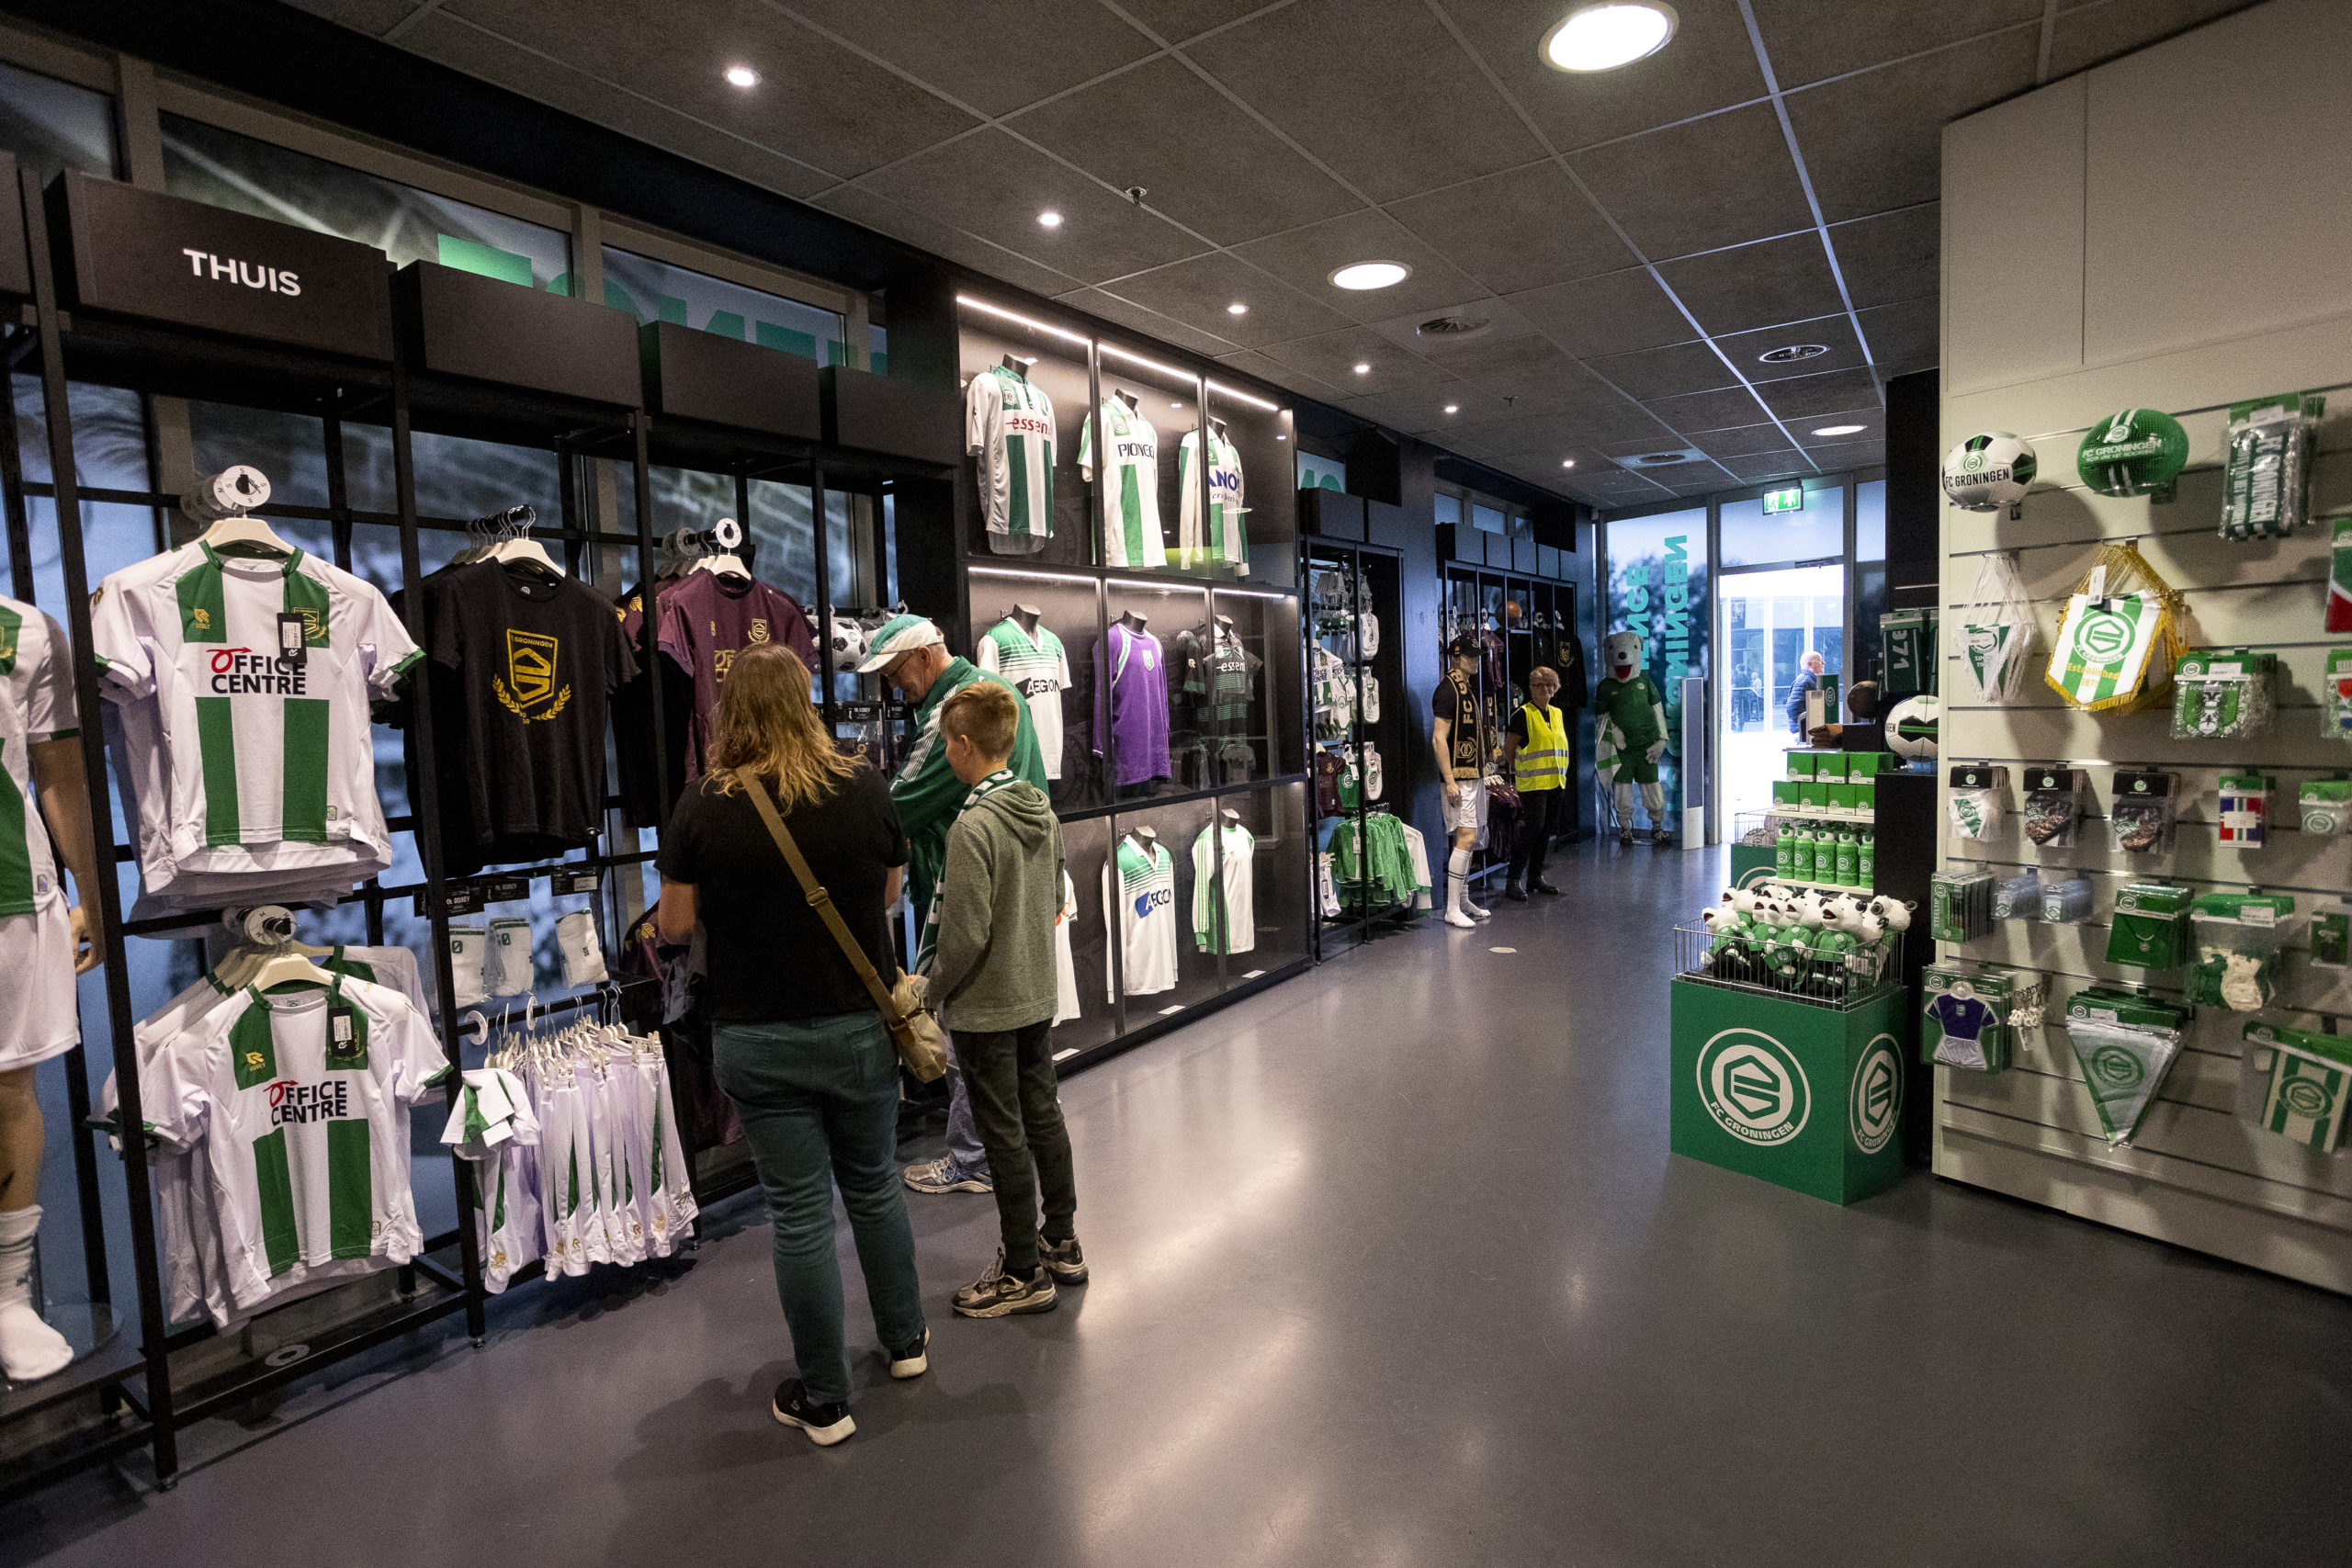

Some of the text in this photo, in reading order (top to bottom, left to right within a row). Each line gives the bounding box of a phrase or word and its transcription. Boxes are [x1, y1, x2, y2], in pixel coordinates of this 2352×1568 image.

[183, 247, 301, 297] THUIS
[1008, 417, 1051, 435] essen
[2083, 438, 2162, 458] FC GRONINGEN
[1945, 468, 2010, 488] FC GRONINGEN
[210, 647, 307, 676] OFFICE
[2066, 662, 2120, 681] Established
[210, 674, 307, 695] CENTRE
[1025, 677, 1060, 695] AEGON
[1463, 699, 1474, 724] FC
[268, 1080, 347, 1108] OFFICE
[270, 1099, 347, 1126] CENTRE
[1710, 1100, 1794, 1140] FC GRONINGEN
[1857, 1110, 1897, 1147] FC GRONINGEN
